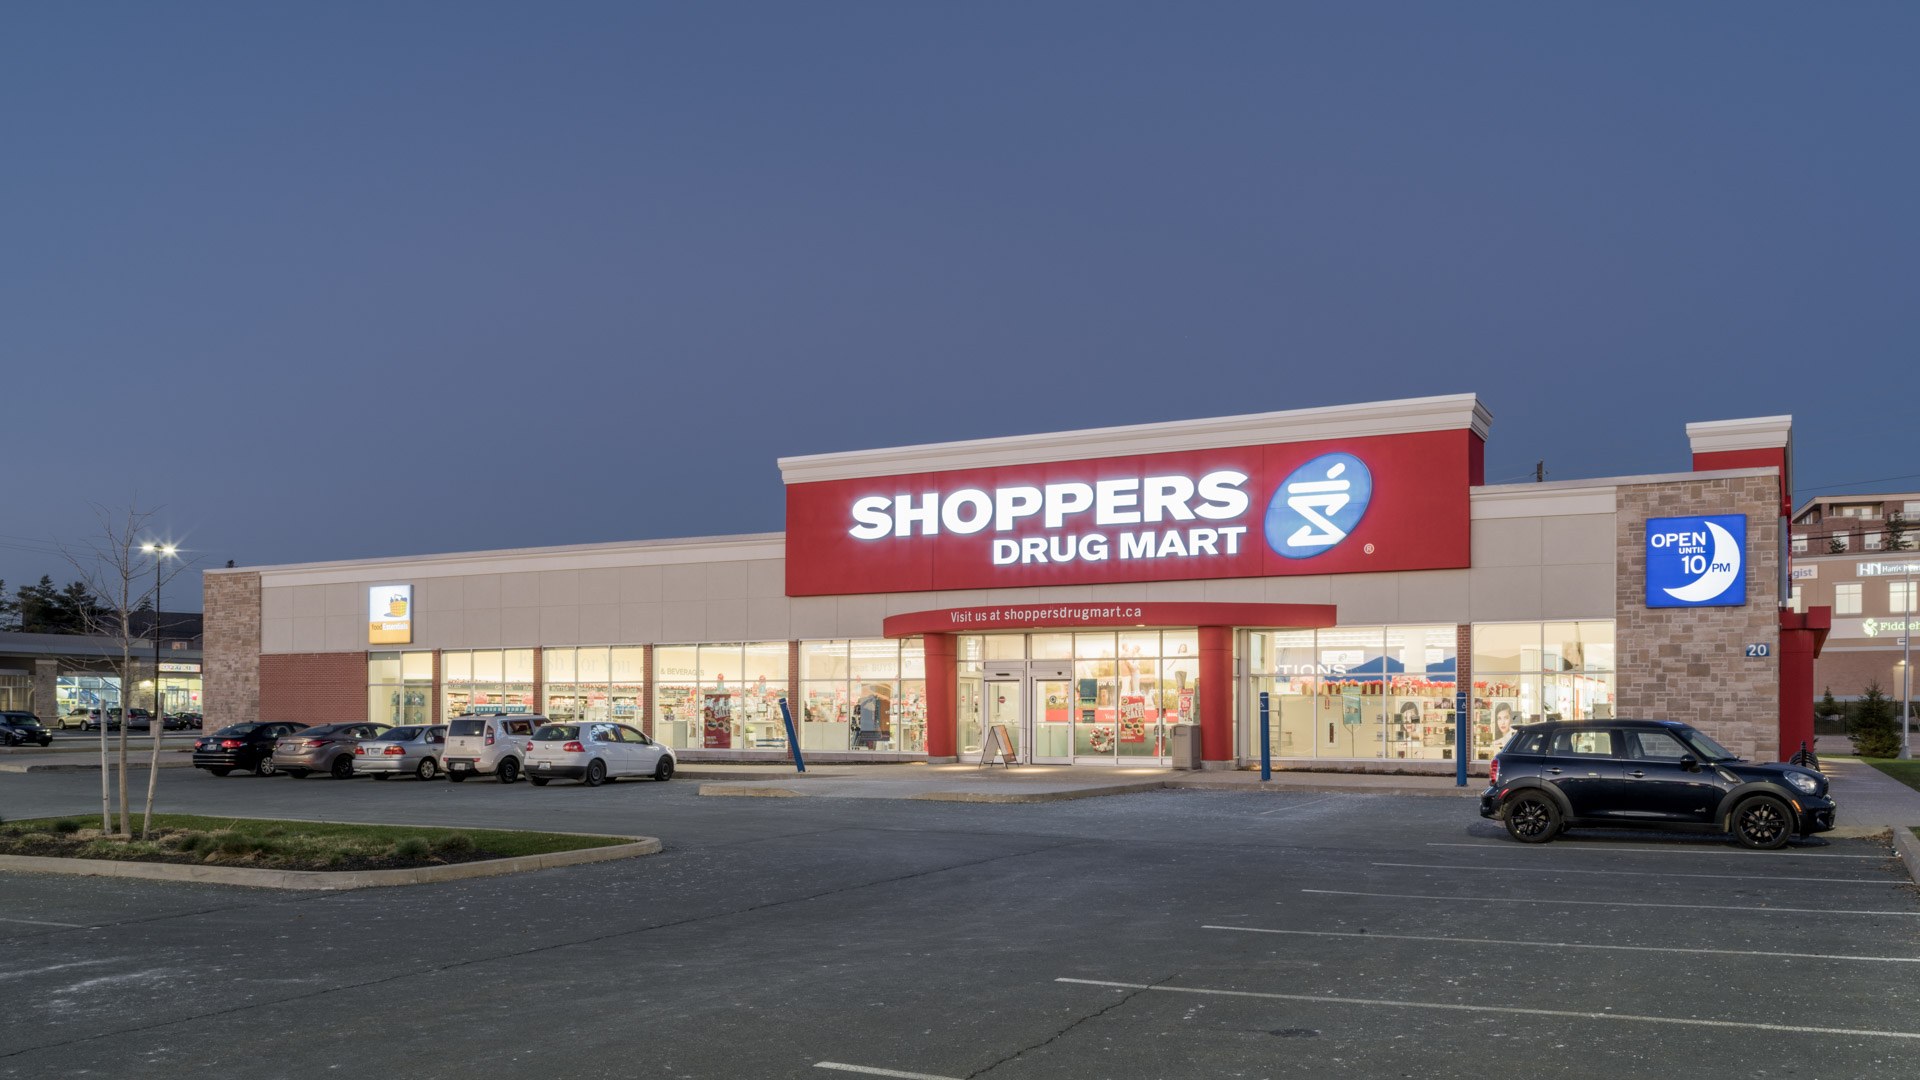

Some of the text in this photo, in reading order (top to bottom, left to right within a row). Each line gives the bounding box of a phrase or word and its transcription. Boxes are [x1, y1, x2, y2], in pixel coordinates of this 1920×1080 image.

[849, 470, 1249, 540] SHOPPERS
[993, 526, 1247, 565] DRUG MART
[1651, 532, 1706, 548] OPEN
[1678, 546, 1706, 554] UNTIL
[1681, 555, 1731, 574] 10 PM
[951, 606, 1142, 623] Visit us at shoppersdrugmart.ca
[1748, 644, 1767, 656] 20
[667, 667, 705, 676] BEVERAGS
[1121, 702, 1144, 713] SUPER
